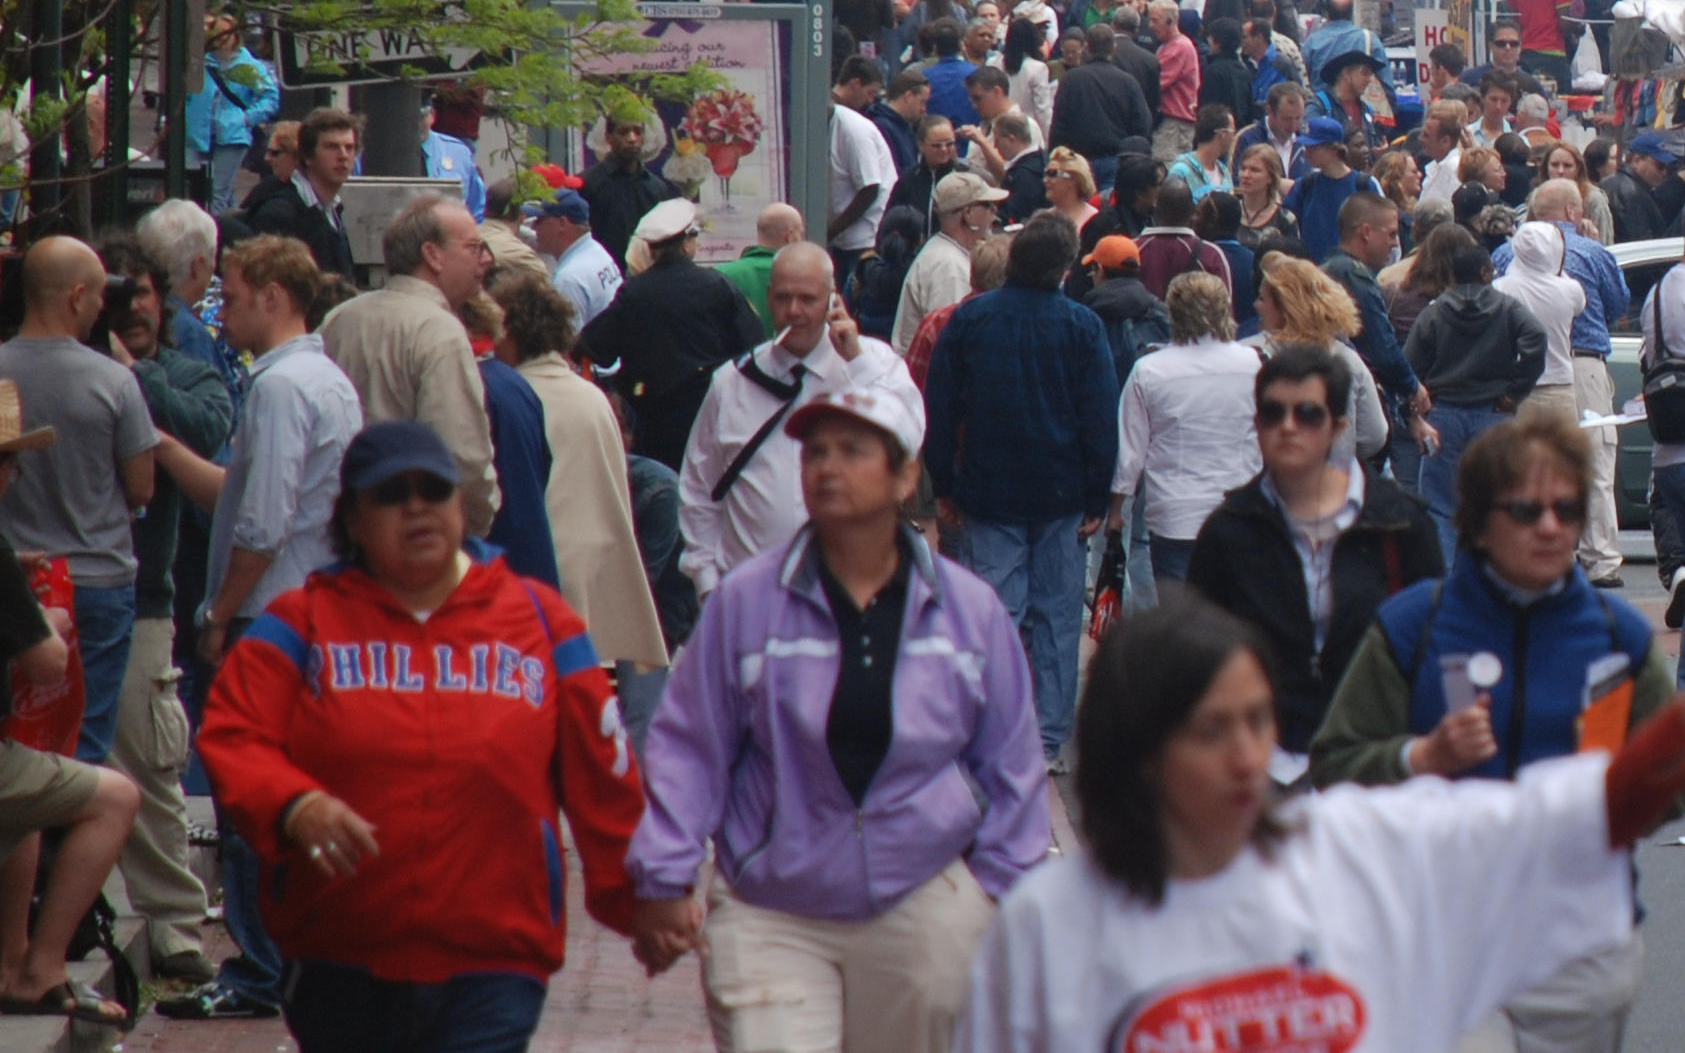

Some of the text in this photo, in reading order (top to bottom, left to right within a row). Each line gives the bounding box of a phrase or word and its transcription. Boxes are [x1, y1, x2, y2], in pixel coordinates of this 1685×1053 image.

[379, 26, 428, 57] WA
[812, 4, 823, 57] 0803
[697, 43, 726, 52] our
[632, 57, 679, 71] newest
